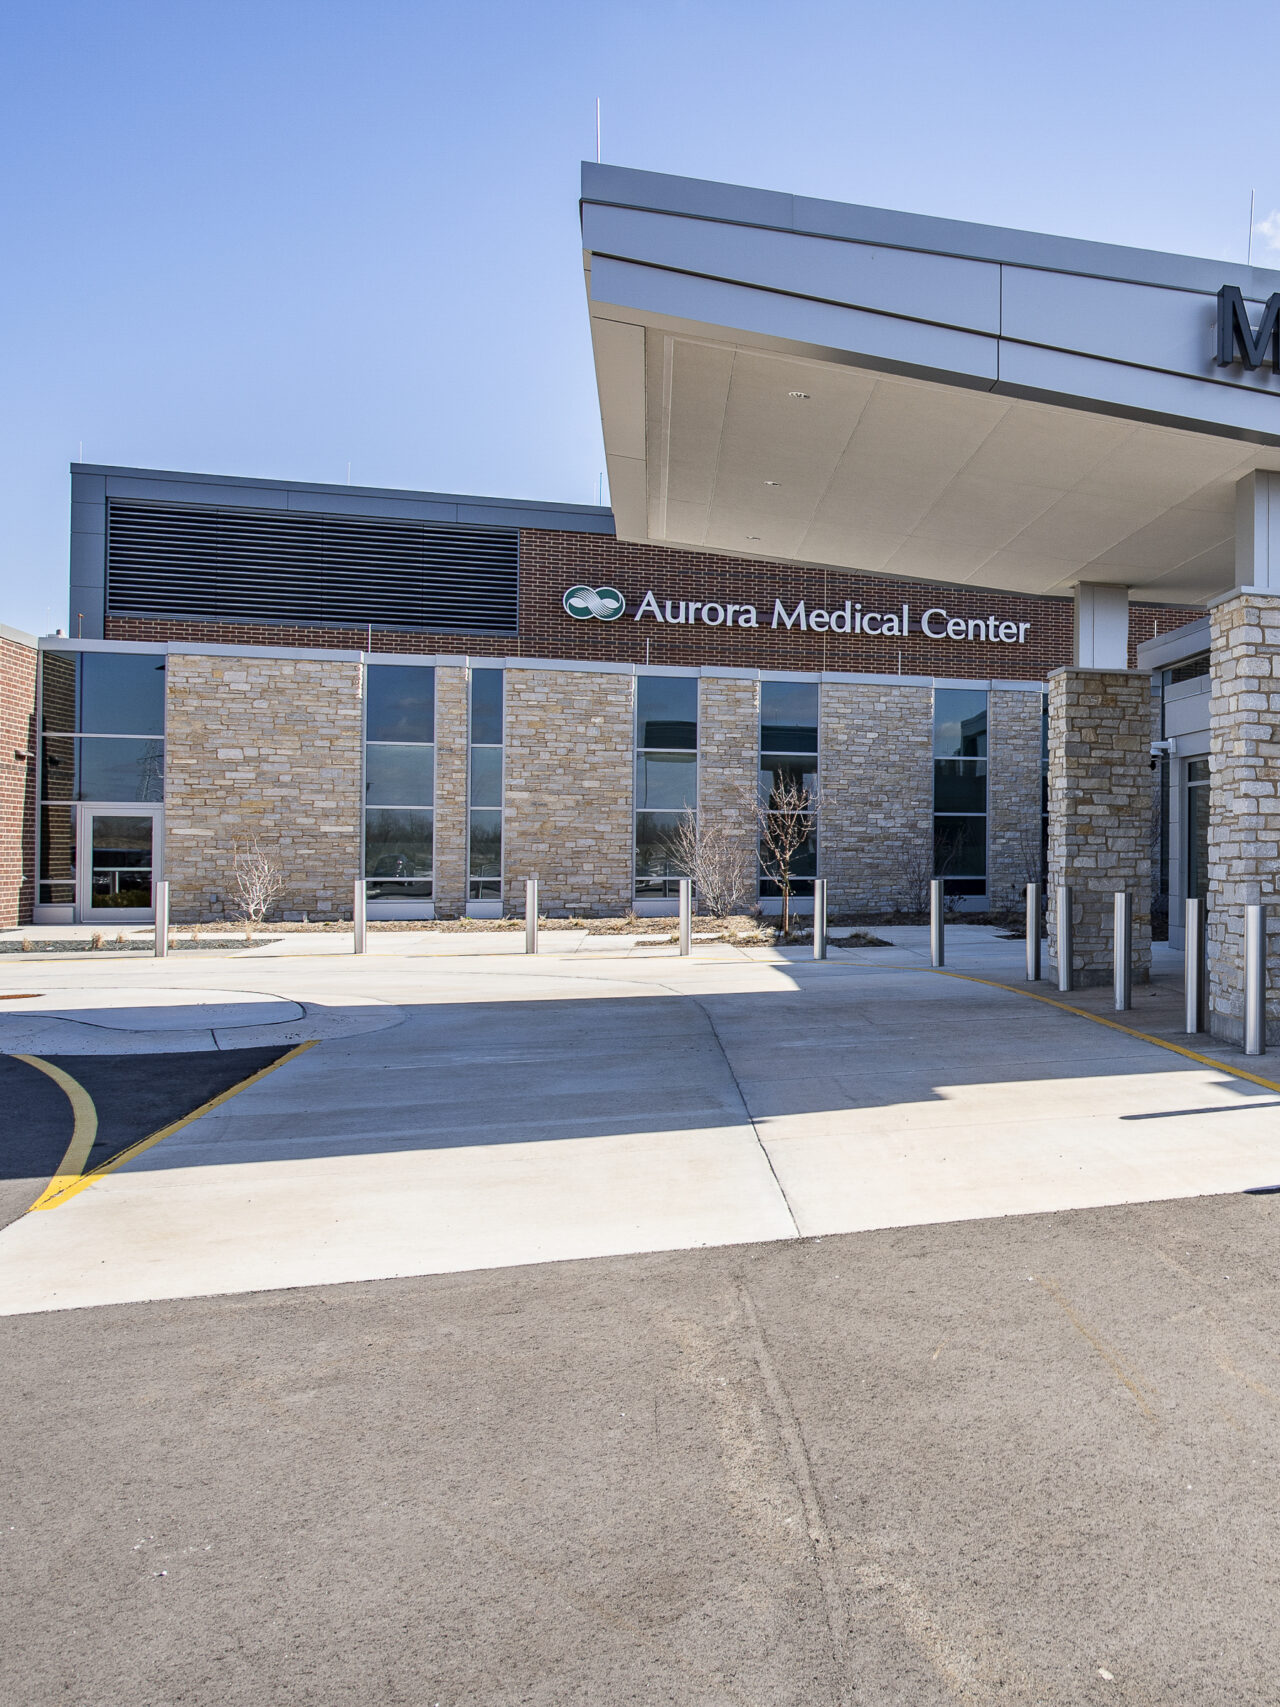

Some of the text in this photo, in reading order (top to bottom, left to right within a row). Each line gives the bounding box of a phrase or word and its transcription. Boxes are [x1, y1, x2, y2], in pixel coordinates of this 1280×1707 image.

[634, 590, 1031, 643] Aurora Medical Center
